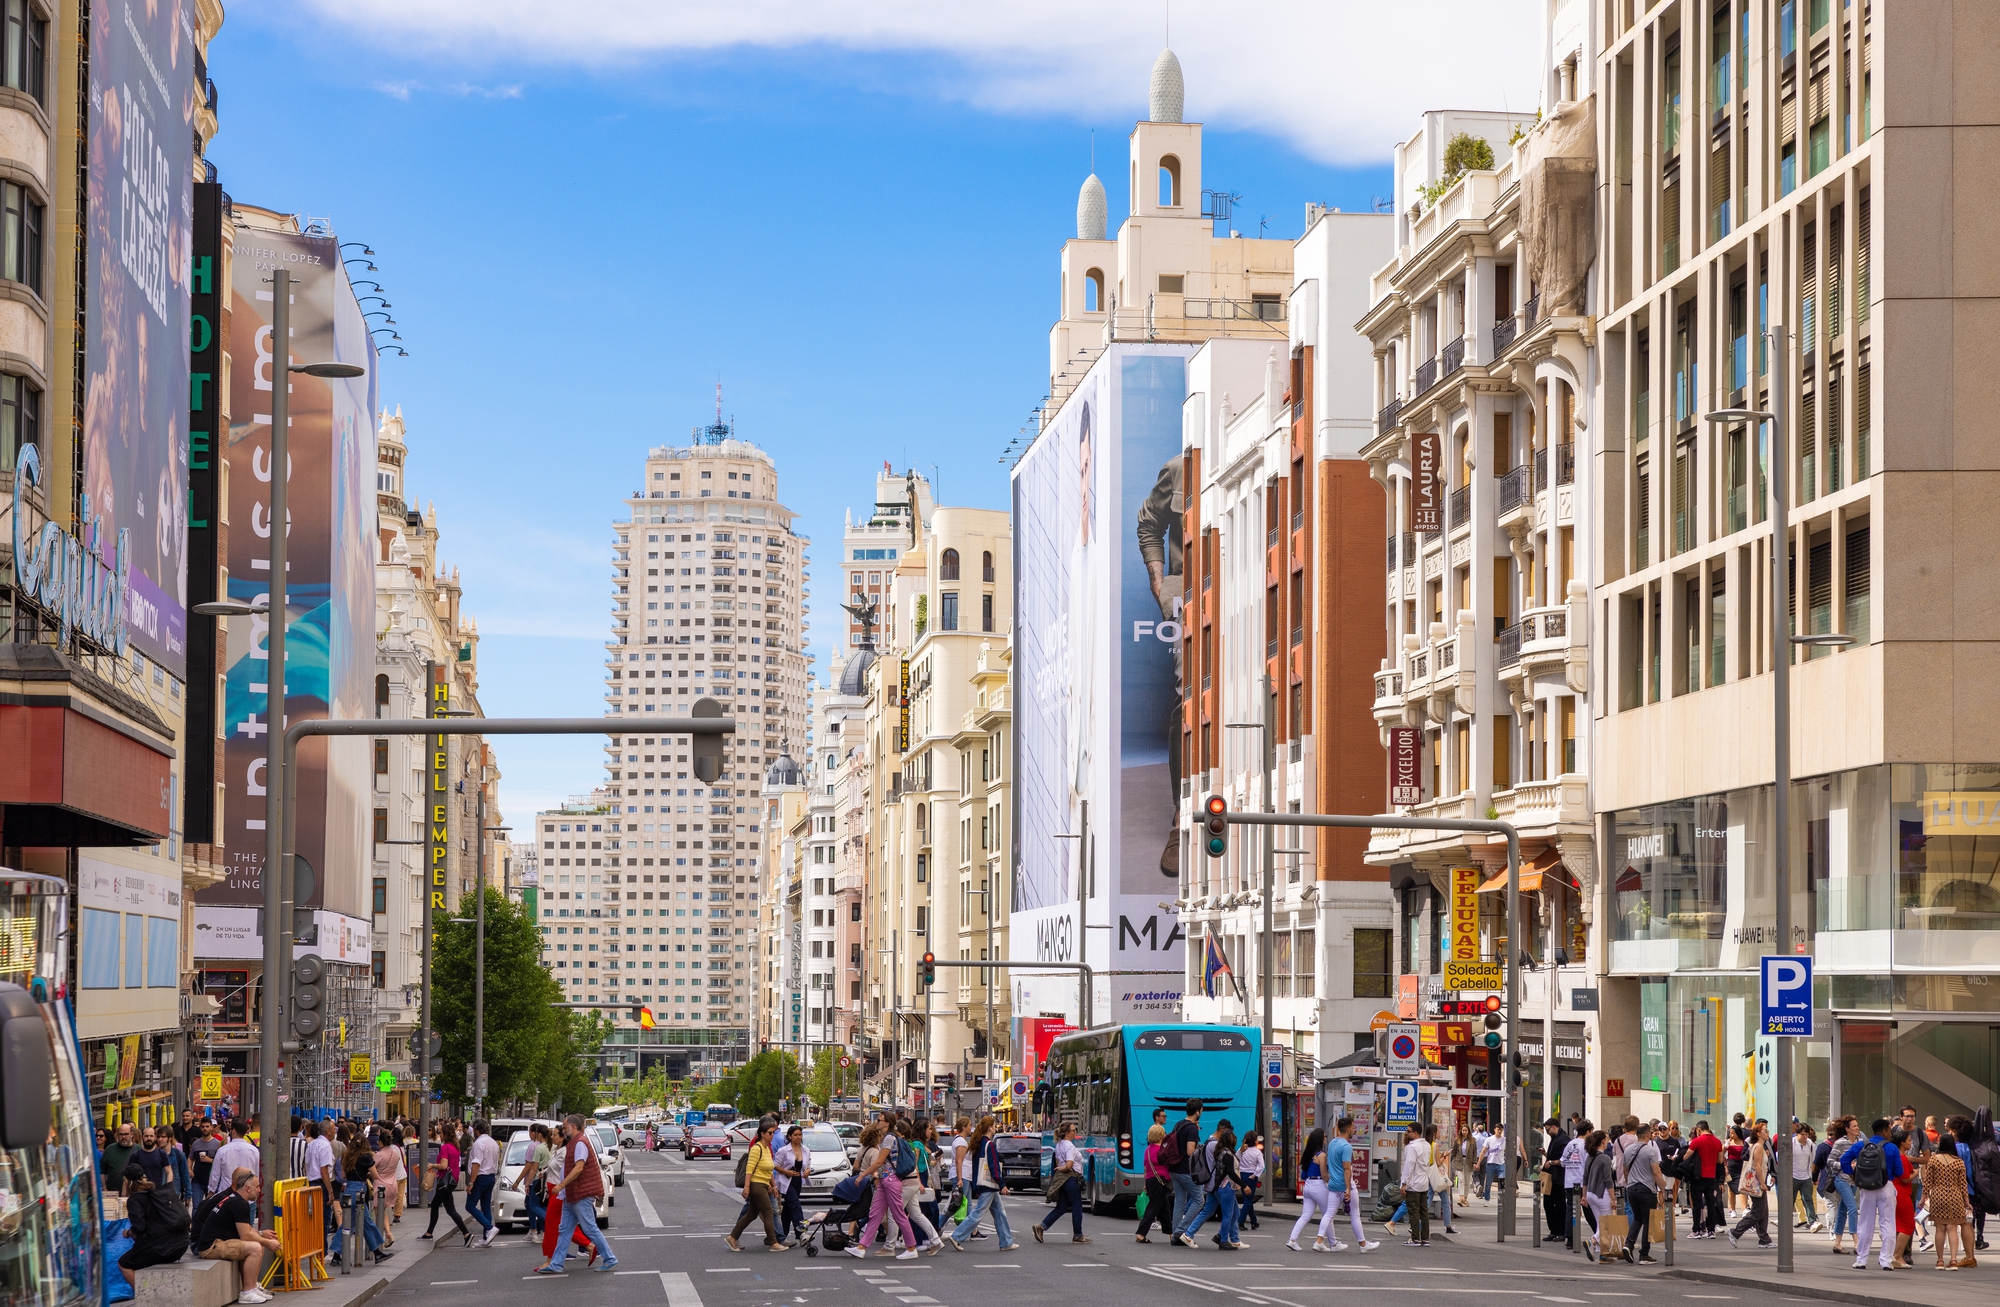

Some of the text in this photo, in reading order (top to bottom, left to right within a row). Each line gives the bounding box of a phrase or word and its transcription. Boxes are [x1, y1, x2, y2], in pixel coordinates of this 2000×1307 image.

[122, 82, 170, 238] POLLOS
[121, 178, 167, 327] CABEZA
[282, 251, 323, 266] LOPEZ
[188, 256, 212, 528] HOTEL
[1421, 437, 1433, 508] LAURIA
[13, 442, 132, 657] Capitol
[1399, 730, 1413, 786] EXCELSIOR
[234, 853, 257, 862] THE
[1628, 834, 1663, 860] HUAWEI
[224, 866, 239, 875] OF
[1455, 870, 1476, 959] PELUCAS
[1036, 914, 1072, 962] MANGO
[1119, 915, 1186, 951] MA
[1733, 926, 1764, 944] HUAWEI
[792, 923, 802, 989] SENATOR
[1448, 964, 1499, 976] Soledad
[1450, 977, 1498, 989] Cabello
[1135, 990, 1182, 1001] exterior
[1767, 960, 1807, 1007] P
[792, 993, 802, 1042] HOTEL
[1457, 1002, 1488, 1013] EXTE
[1643, 1016, 1659, 1032] GRAN
[1768, 1023, 1783, 1033] 24
[1555, 1045, 1582, 1059] DECIMAS
[1647, 1034, 1665, 1049] VIEW
[1608, 1080, 1623, 1090] AT
[1390, 1083, 1416, 1114] P
